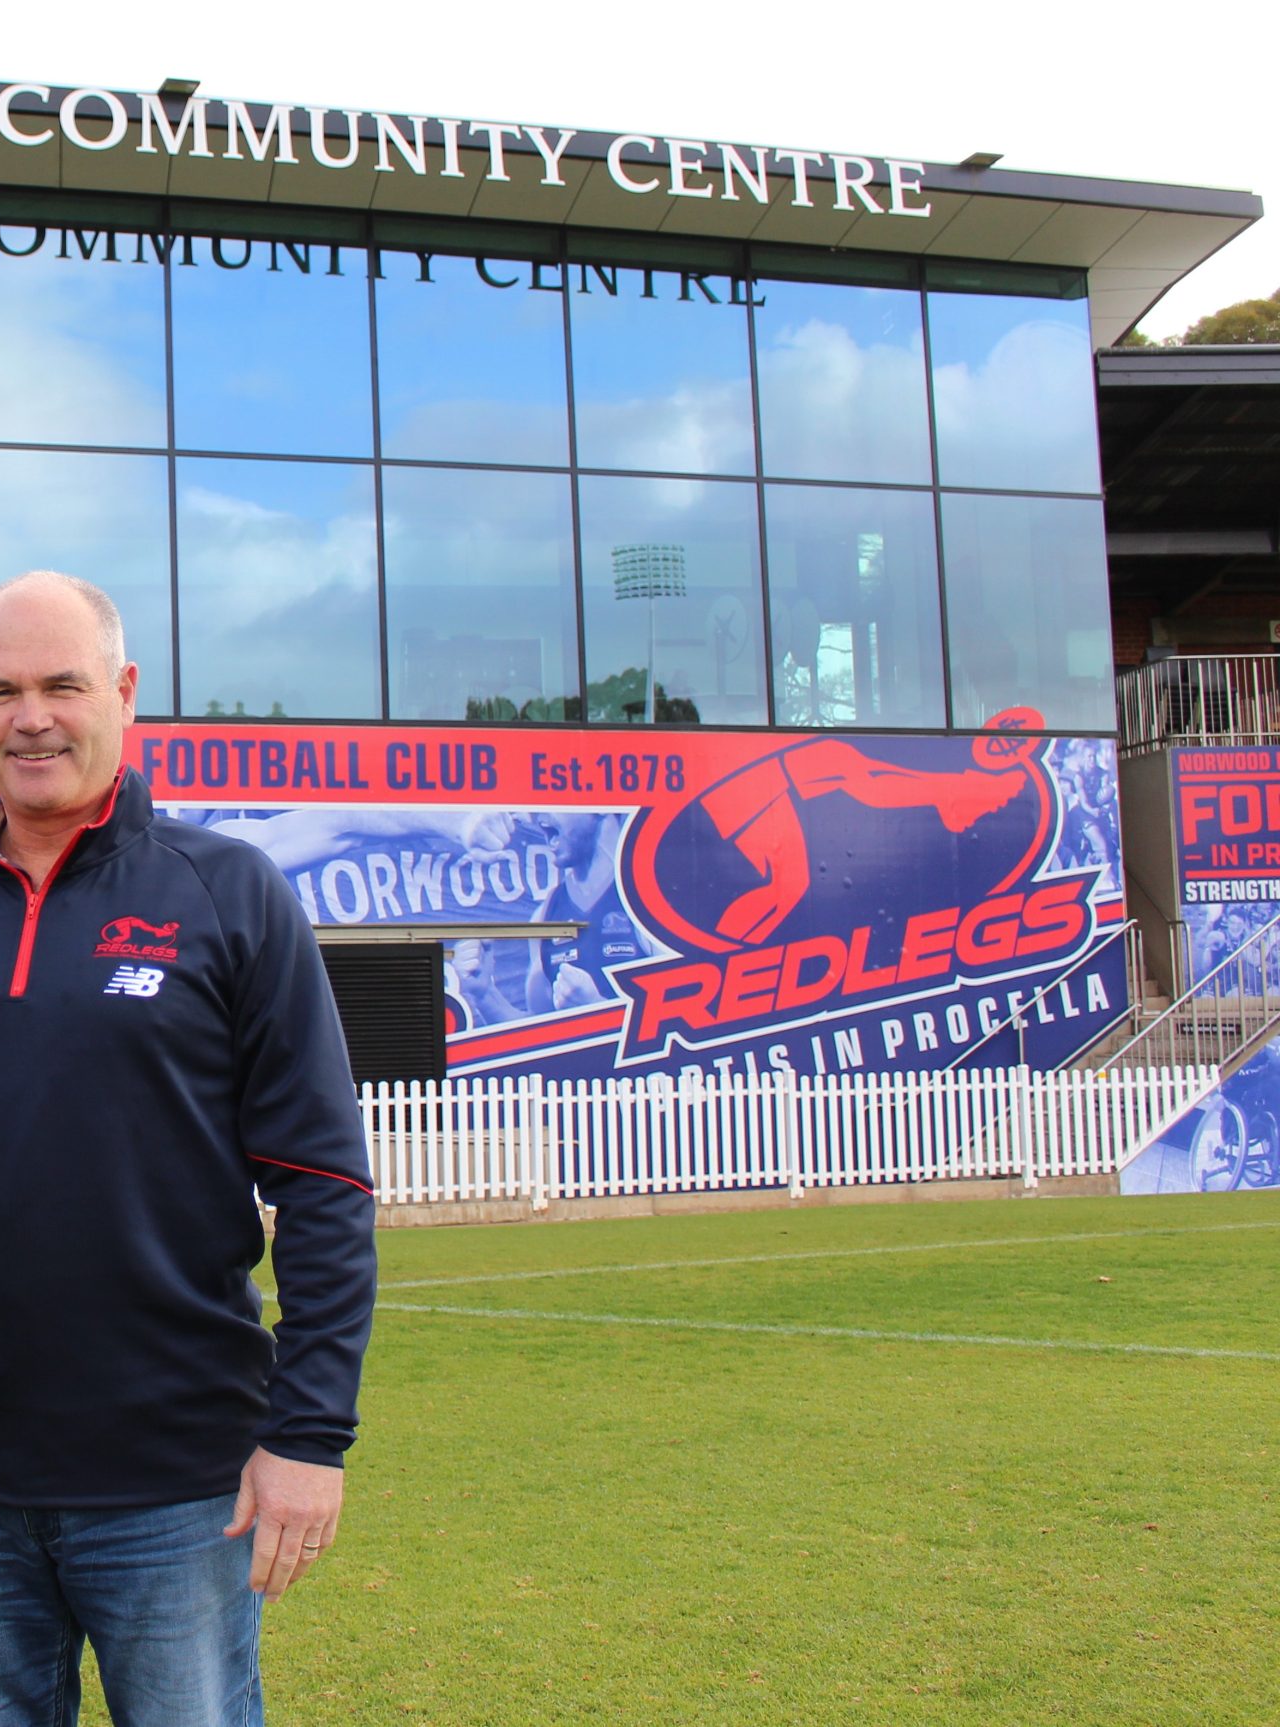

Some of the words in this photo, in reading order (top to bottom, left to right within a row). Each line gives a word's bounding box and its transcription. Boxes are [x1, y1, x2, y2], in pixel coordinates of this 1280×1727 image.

[606, 133, 932, 218] CENTRE
[141, 738, 370, 790] FOOTBALL
[386, 742, 499, 791] CLUB
[530, 752, 686, 793] Est.1878
[1177, 751, 1271, 772] NORWOOD
[1210, 843, 1239, 867] IN
[1185, 879, 1280, 902] STRENGTH
[95, 943, 178, 958] REDLEGS
[631, 880, 1086, 1043] REDLEGS
[810, 1027, 865, 1075] IN
[880, 973, 1111, 1060] PROCELLA
